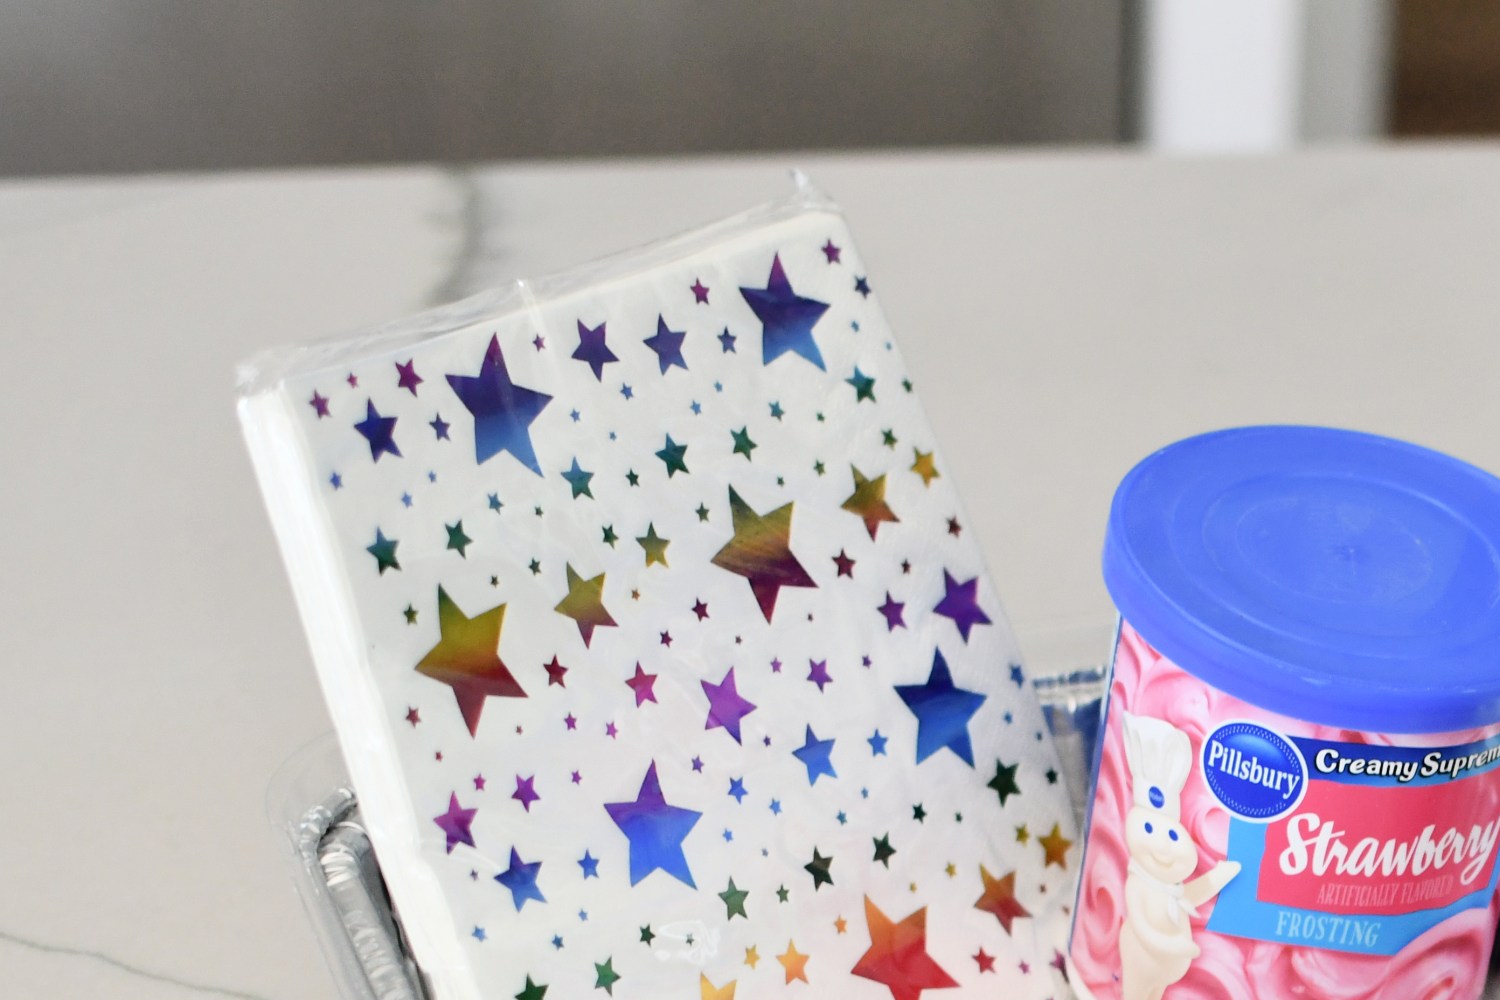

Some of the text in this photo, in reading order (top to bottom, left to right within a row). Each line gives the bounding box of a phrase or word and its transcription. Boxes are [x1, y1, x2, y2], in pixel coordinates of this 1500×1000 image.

[1208, 740, 1301, 800] Pillsbury
[1315, 748, 1420, 781] Creamy
[1316, 882, 1400, 908] ARTIFICIALLY
[1275, 909, 1382, 948] FROSTING
